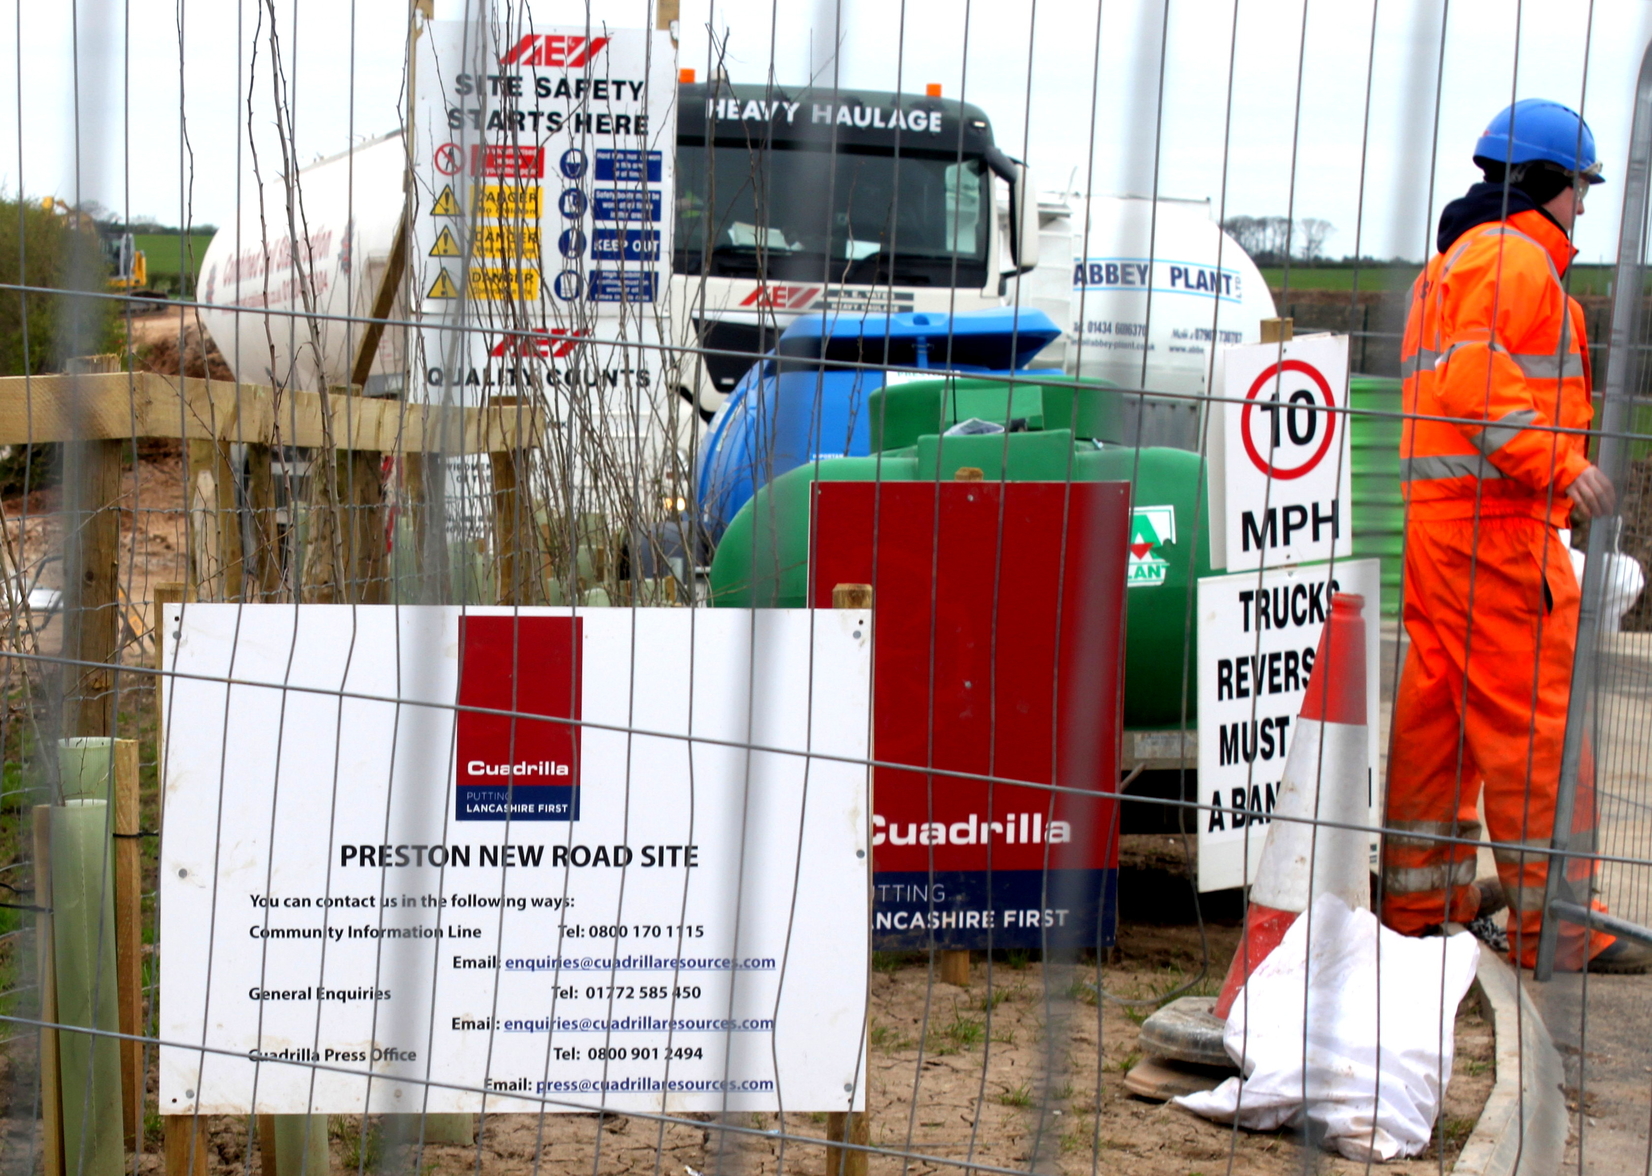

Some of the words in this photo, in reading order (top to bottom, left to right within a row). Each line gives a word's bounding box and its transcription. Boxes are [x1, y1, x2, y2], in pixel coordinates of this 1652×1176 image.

[455, 74, 523, 97] SITE
[535, 76, 644, 101] SAFETY
[448, 108, 562, 132] STARTS
[575, 112, 649, 135] HERE
[706, 98, 800, 123] HEAVY
[811, 103, 942, 132] HAULAGE
[477, 191, 538, 203] ANGER
[593, 239, 629, 252] KEEP
[632, 239, 660, 253] OUT
[1073, 263, 1148, 286] ABBEY
[1170, 266, 1232, 295] PLANT
[427, 366, 534, 387] QUALITY
[546, 367, 650, 387] COUNTS
[1260, 389, 1317, 448] 10
[1241, 498, 1340, 552] MPH
[1219, 716, 1290, 766] MUST
[467, 760, 569, 776] Cuadrilla
[466, 804, 535, 813] LANCASHIRE
[538, 804, 568, 813] FIRST
[1208, 791, 1225, 833] A
[340, 845, 470, 868] PRESTON
[479, 845, 544, 868] NEW
[552, 845, 633, 868] ROAD
[641, 845, 699, 868] SITE
[872, 884, 945, 902] TTING
[250, 894, 279, 908] You
[283, 897, 311, 908] can
[315, 895, 375, 908] contact
[381, 898, 397, 908] us
[401, 894, 417, 908] in
[421, 894, 447, 908] the
[451, 894, 526, 911] following
[531, 897, 575, 911] ways:
[872, 910, 995, 929] NCASHIRE
[1003, 909, 1069, 929] FIRST
[249, 925, 344, 942] Community
[348, 925, 444, 939] Information
[449, 925, 482, 938] Line
[558, 925, 585, 938] Tel:
[589, 925, 628, 938] 0800
[633, 925, 661, 938] 170
[667, 925, 704, 938] 1115
[453, 956, 501, 969] Email:
[505, 956, 776, 972] enquiries@cuadrillaresources.com
[249, 987, 312, 1001] General
[317, 987, 391, 1003] Enquiries
[551, 986, 578, 999] Tel:
[585, 986, 634, 999] 01772
[639, 986, 667, 999] 585
[672, 986, 701, 999] 450
[451, 1017, 500, 1031] Email:
[503, 1017, 774, 1033] enquiries@cuadrillaresources.com
[248, 1048, 320, 1063] Cuadrilla
[324, 1048, 366, 1062] Press
[370, 1048, 417, 1062] Office
[553, 1047, 580, 1060] Tel:
[588, 1047, 627, 1060] 0800
[631, 1047, 659, 1060] 901
[664, 1047, 703, 1060] 2494
[485, 1077, 532, 1091] Email:
[536, 1077, 774, 1094] press@cuadrillaresources.com
